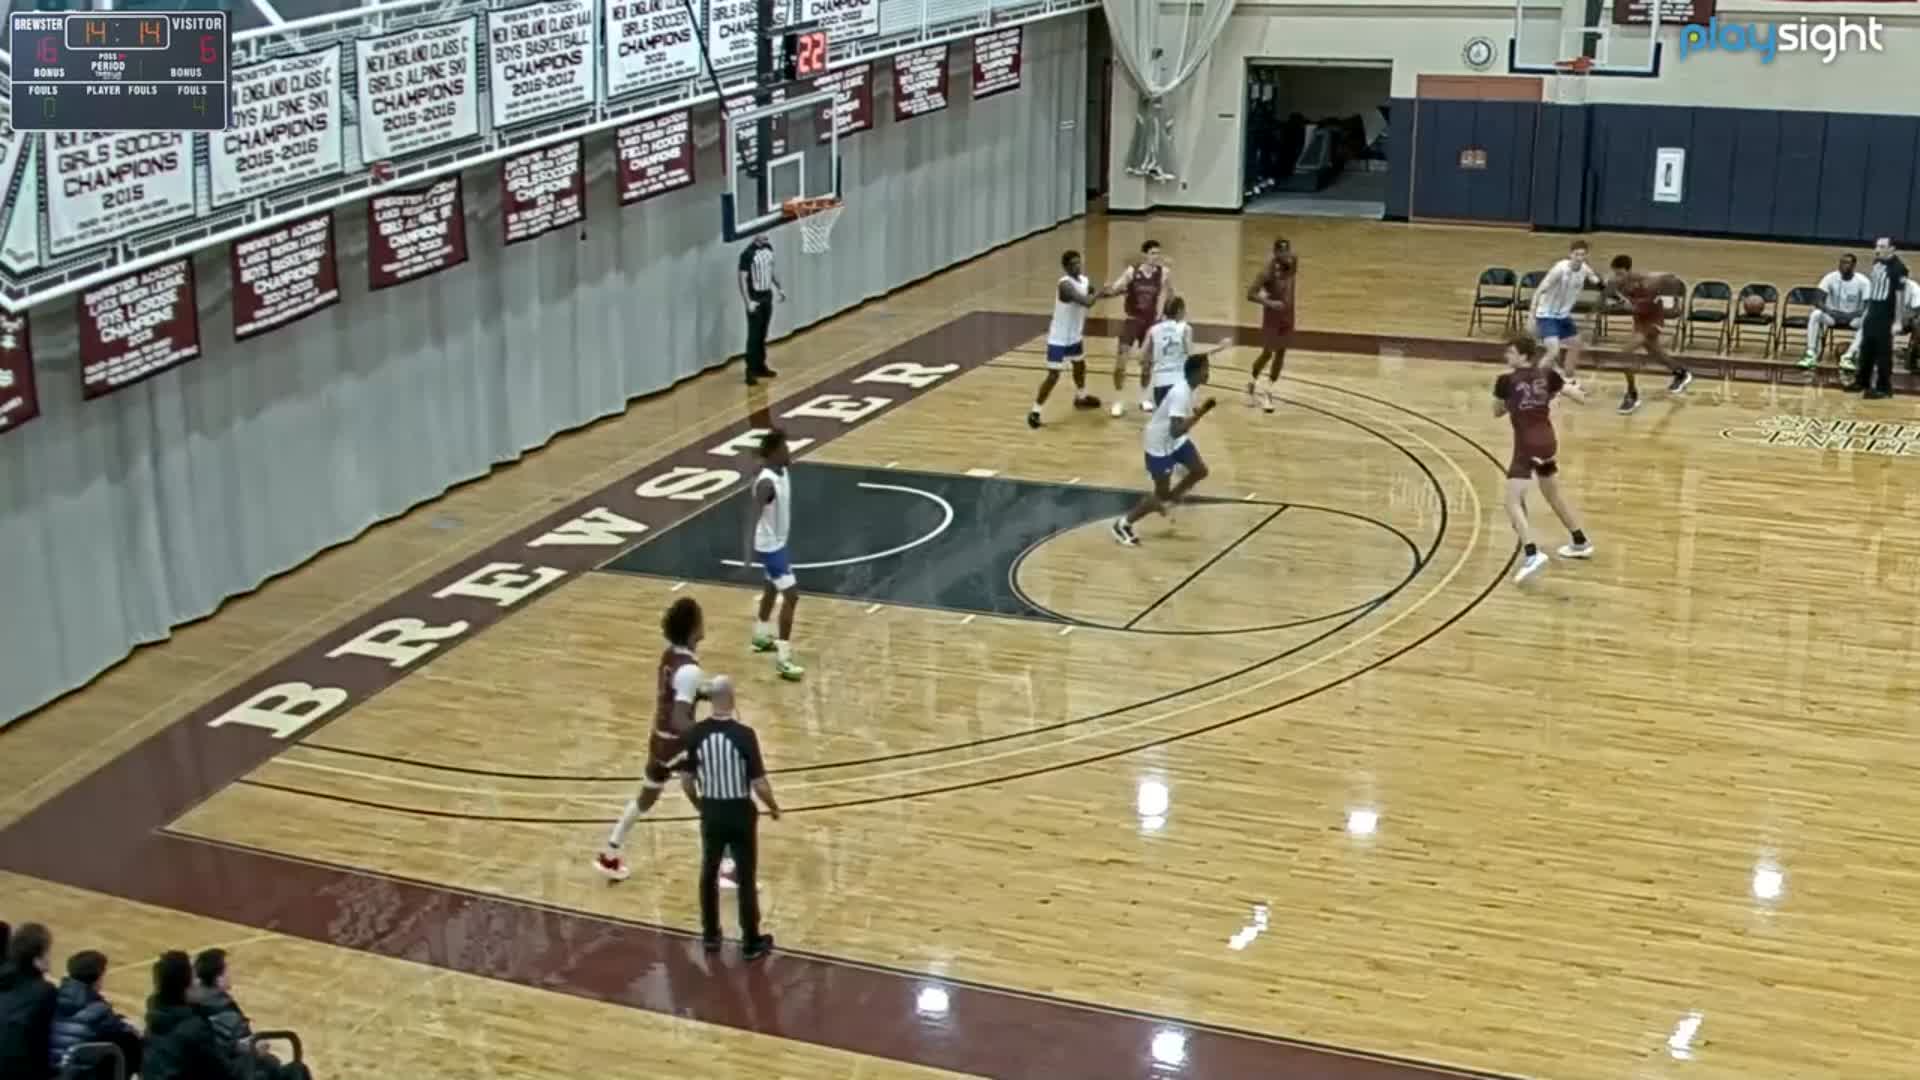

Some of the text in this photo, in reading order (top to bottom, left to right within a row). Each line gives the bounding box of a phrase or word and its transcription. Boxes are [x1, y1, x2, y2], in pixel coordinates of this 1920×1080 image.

[618, 27, 691, 58] CHAMPIONS
[799, 32, 826, 73] 22
[368, 71, 403, 95] GIRLS
[406, 61, 446, 86] ALPINE
[503, 49, 583, 81] CHAMPIONS
[233, 106, 258, 131] OYS
[260, 95, 305, 123] ALPINE
[372, 78, 465, 116] CHAMPIONS
[223, 112, 328, 155] CHAMPIONS
[383, 101, 457, 132] 2015-2016
[57, 143, 110, 174] GIRLS
[114, 131, 183, 159] SOCCER
[235, 137, 319, 174] 2015-2016
[63, 150, 179, 198] CHAMPIONS
[101, 184, 145, 210] 2015
[100, 305, 174, 344] CHAMPIONS
[207, 360, 962, 740] BREWSTER
